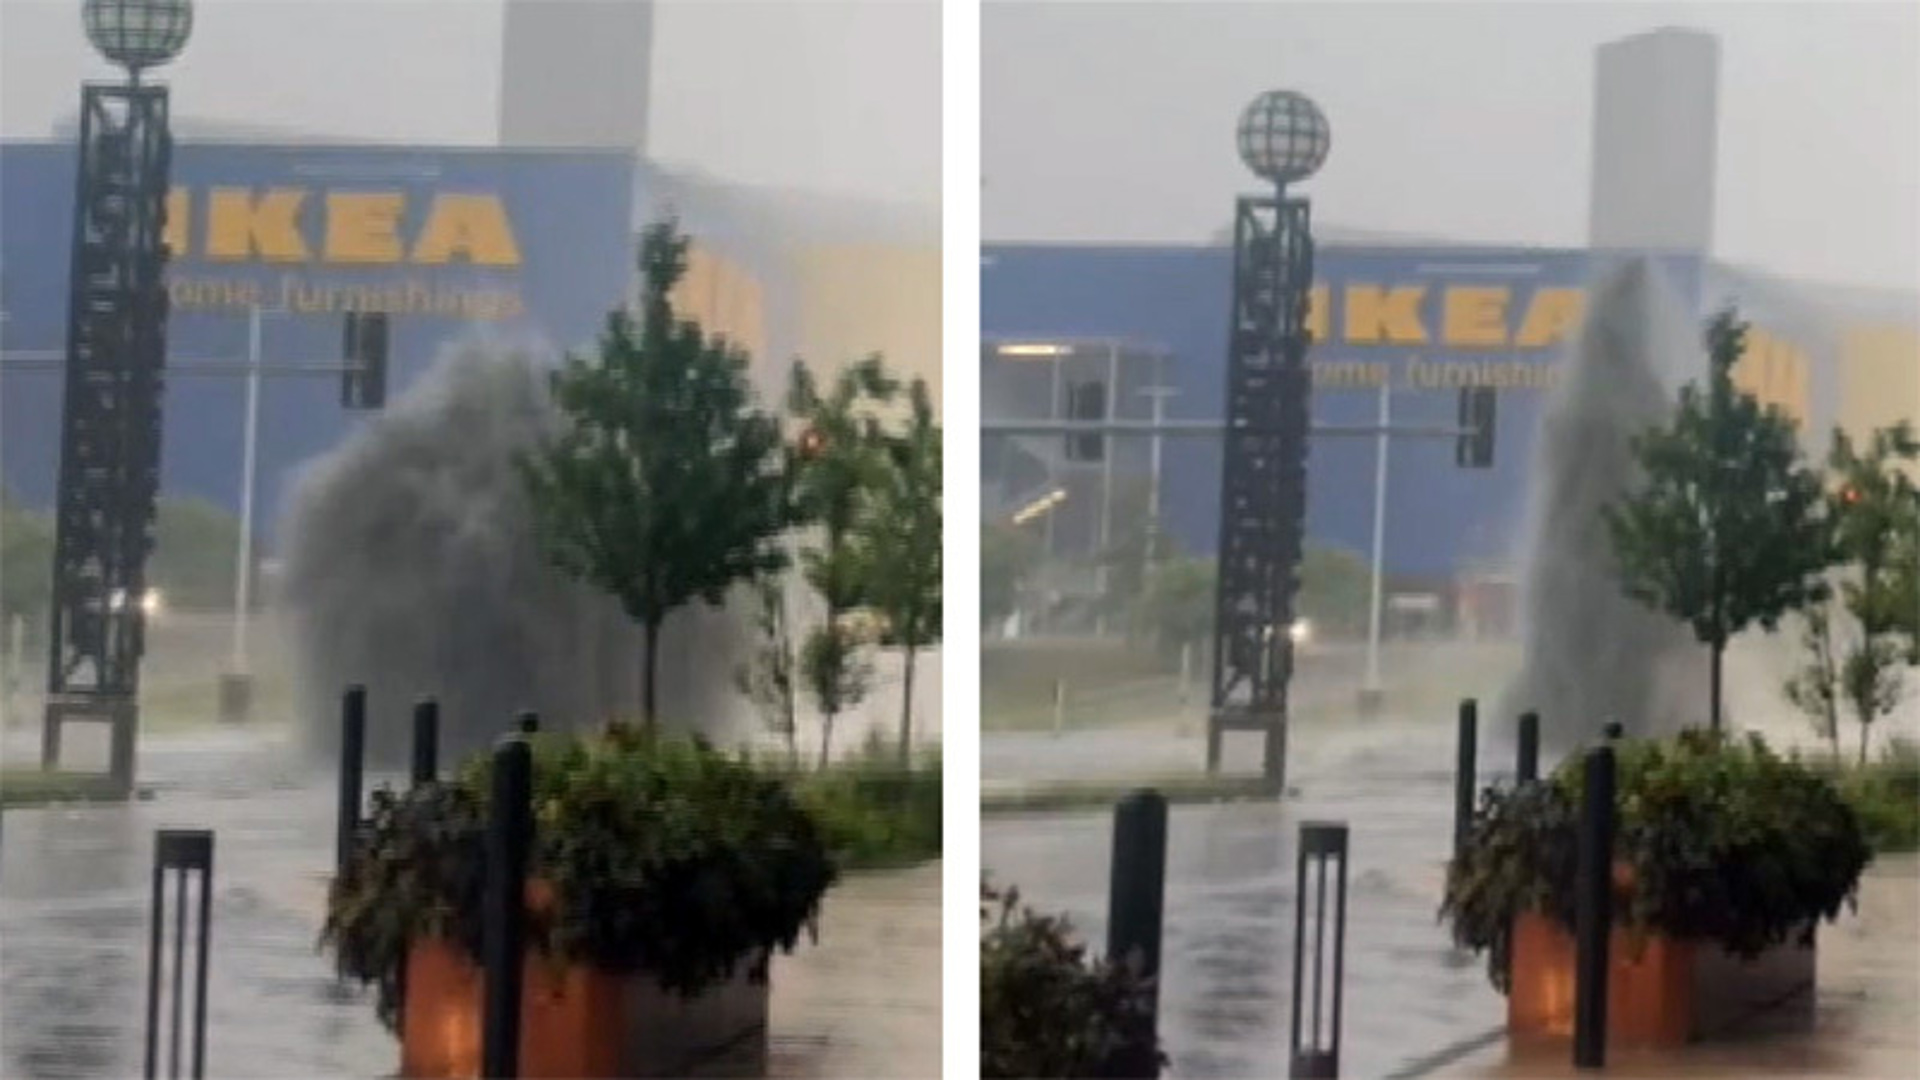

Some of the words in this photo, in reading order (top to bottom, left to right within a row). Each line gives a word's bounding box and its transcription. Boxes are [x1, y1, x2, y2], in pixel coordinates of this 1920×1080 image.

[163, 186, 523, 265] IKEA
[169, 280, 259, 309] ome
[1305, 284, 1590, 348] IKEA
[1311, 360, 1389, 387] ome
